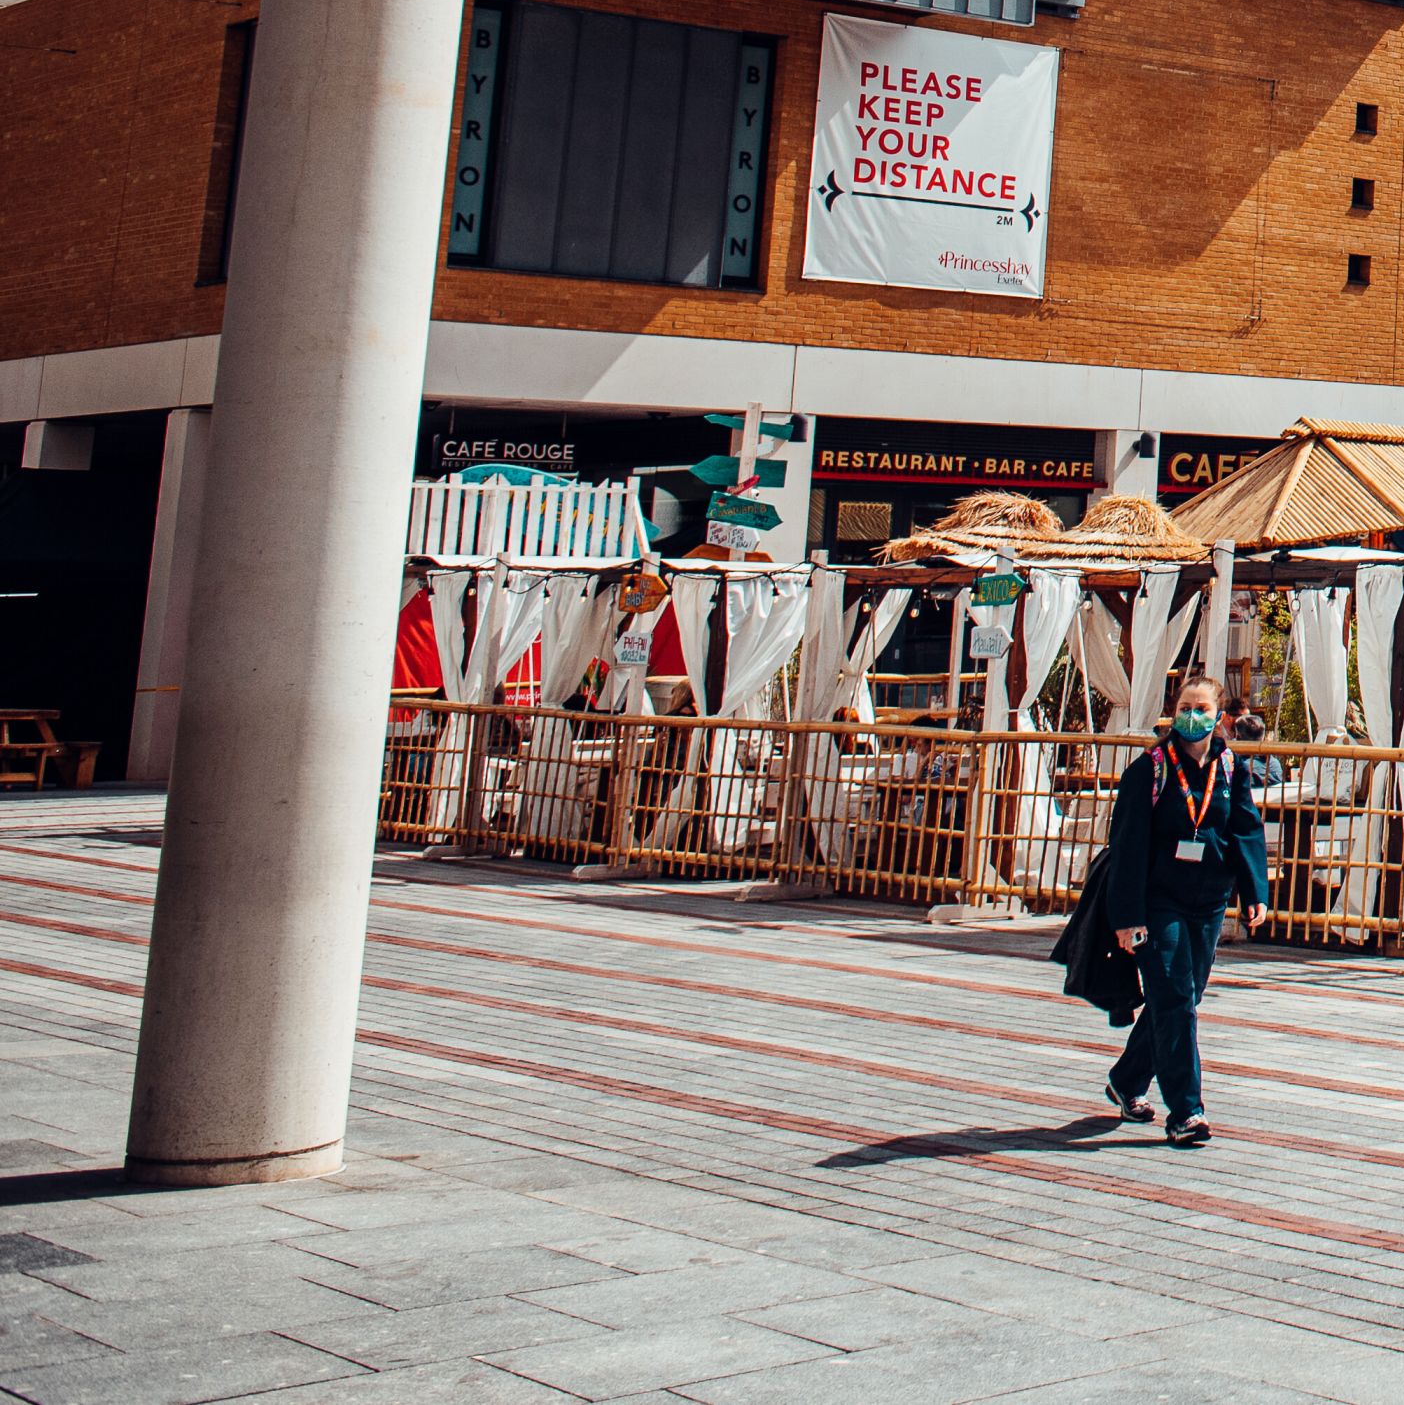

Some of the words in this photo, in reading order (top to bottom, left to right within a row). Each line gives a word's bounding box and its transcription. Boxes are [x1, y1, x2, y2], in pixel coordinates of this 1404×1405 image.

[860, 62, 982, 103] PLEASE
[858, 94, 944, 127] KEEP
[454, 29, 492, 234] BYRON
[855, 125, 951, 161] YOUR
[729, 66, 761, 258] BYRON
[853, 158, 1017, 200] DISTANCE
[996, 215, 1013, 226] 2M
[944, 251, 1032, 282] Princesshay
[997, 274, 1023, 286] Exeter
[443, 439, 498, 457] CAFÉ
[503, 443, 575, 460] ROUGE
[821, 450, 967, 474] RESTAURANT
[985, 458, 1026, 475] BAR
[1043, 460, 1094, 478] CAFE
[976, 579, 1009, 603] EXICO
